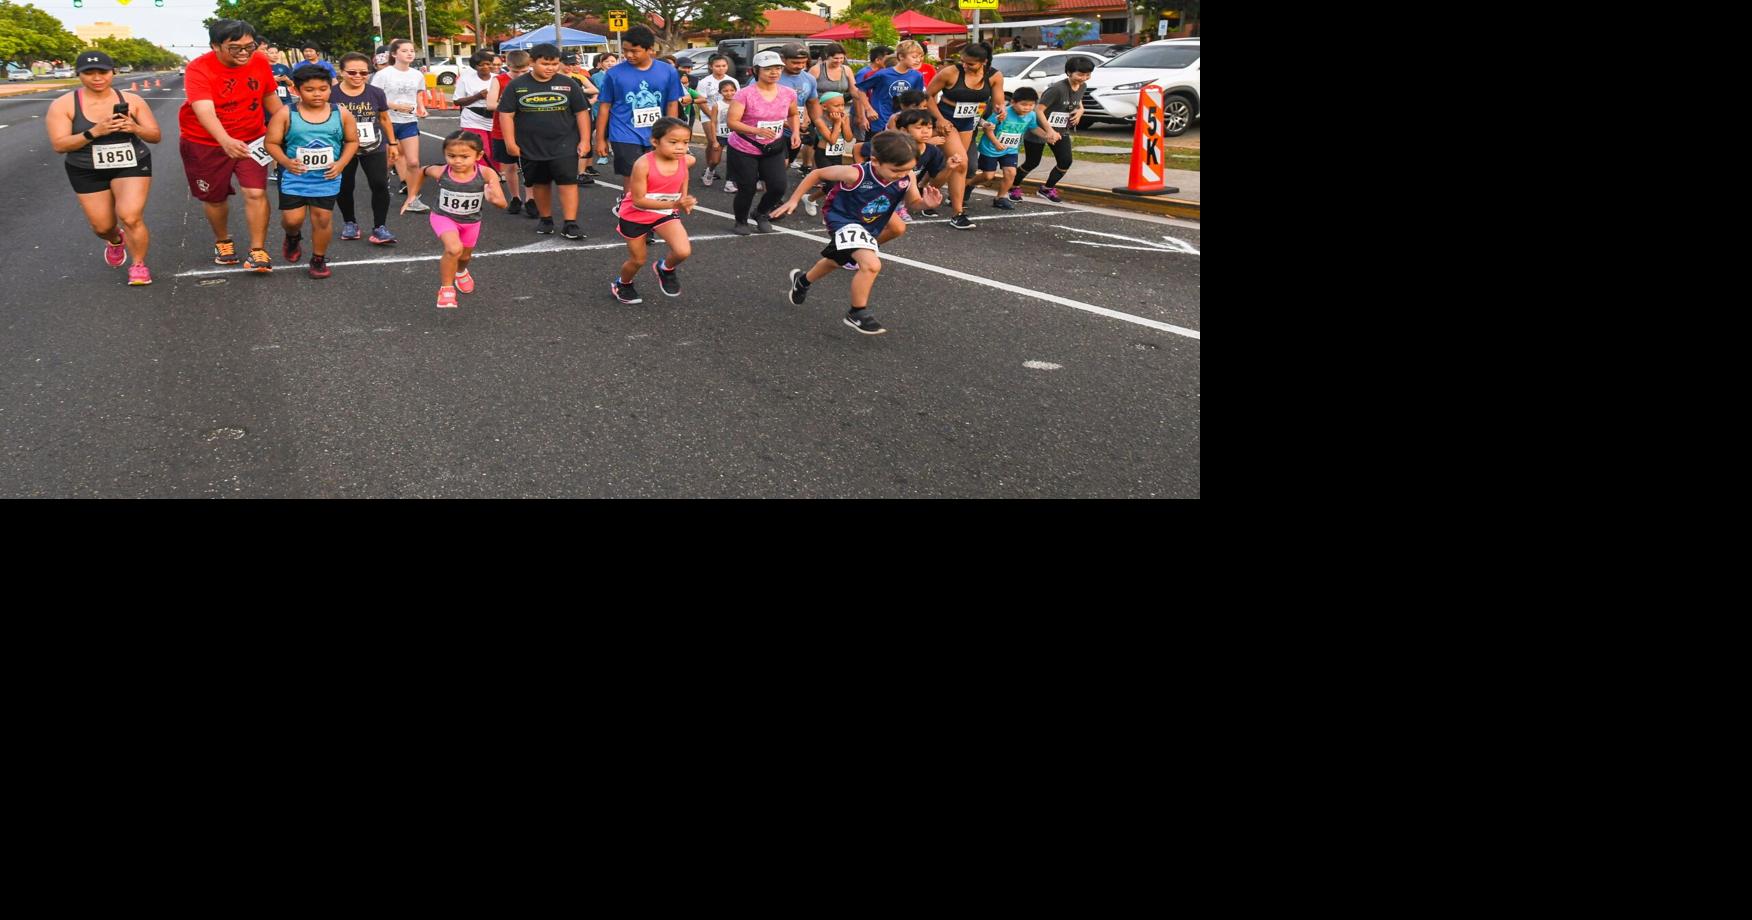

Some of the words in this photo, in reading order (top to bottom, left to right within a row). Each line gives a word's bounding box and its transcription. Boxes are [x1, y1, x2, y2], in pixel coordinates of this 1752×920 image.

[97, 149, 133, 164] 1850
[303, 154, 328, 165] 800
[443, 196, 480, 210] 1849
